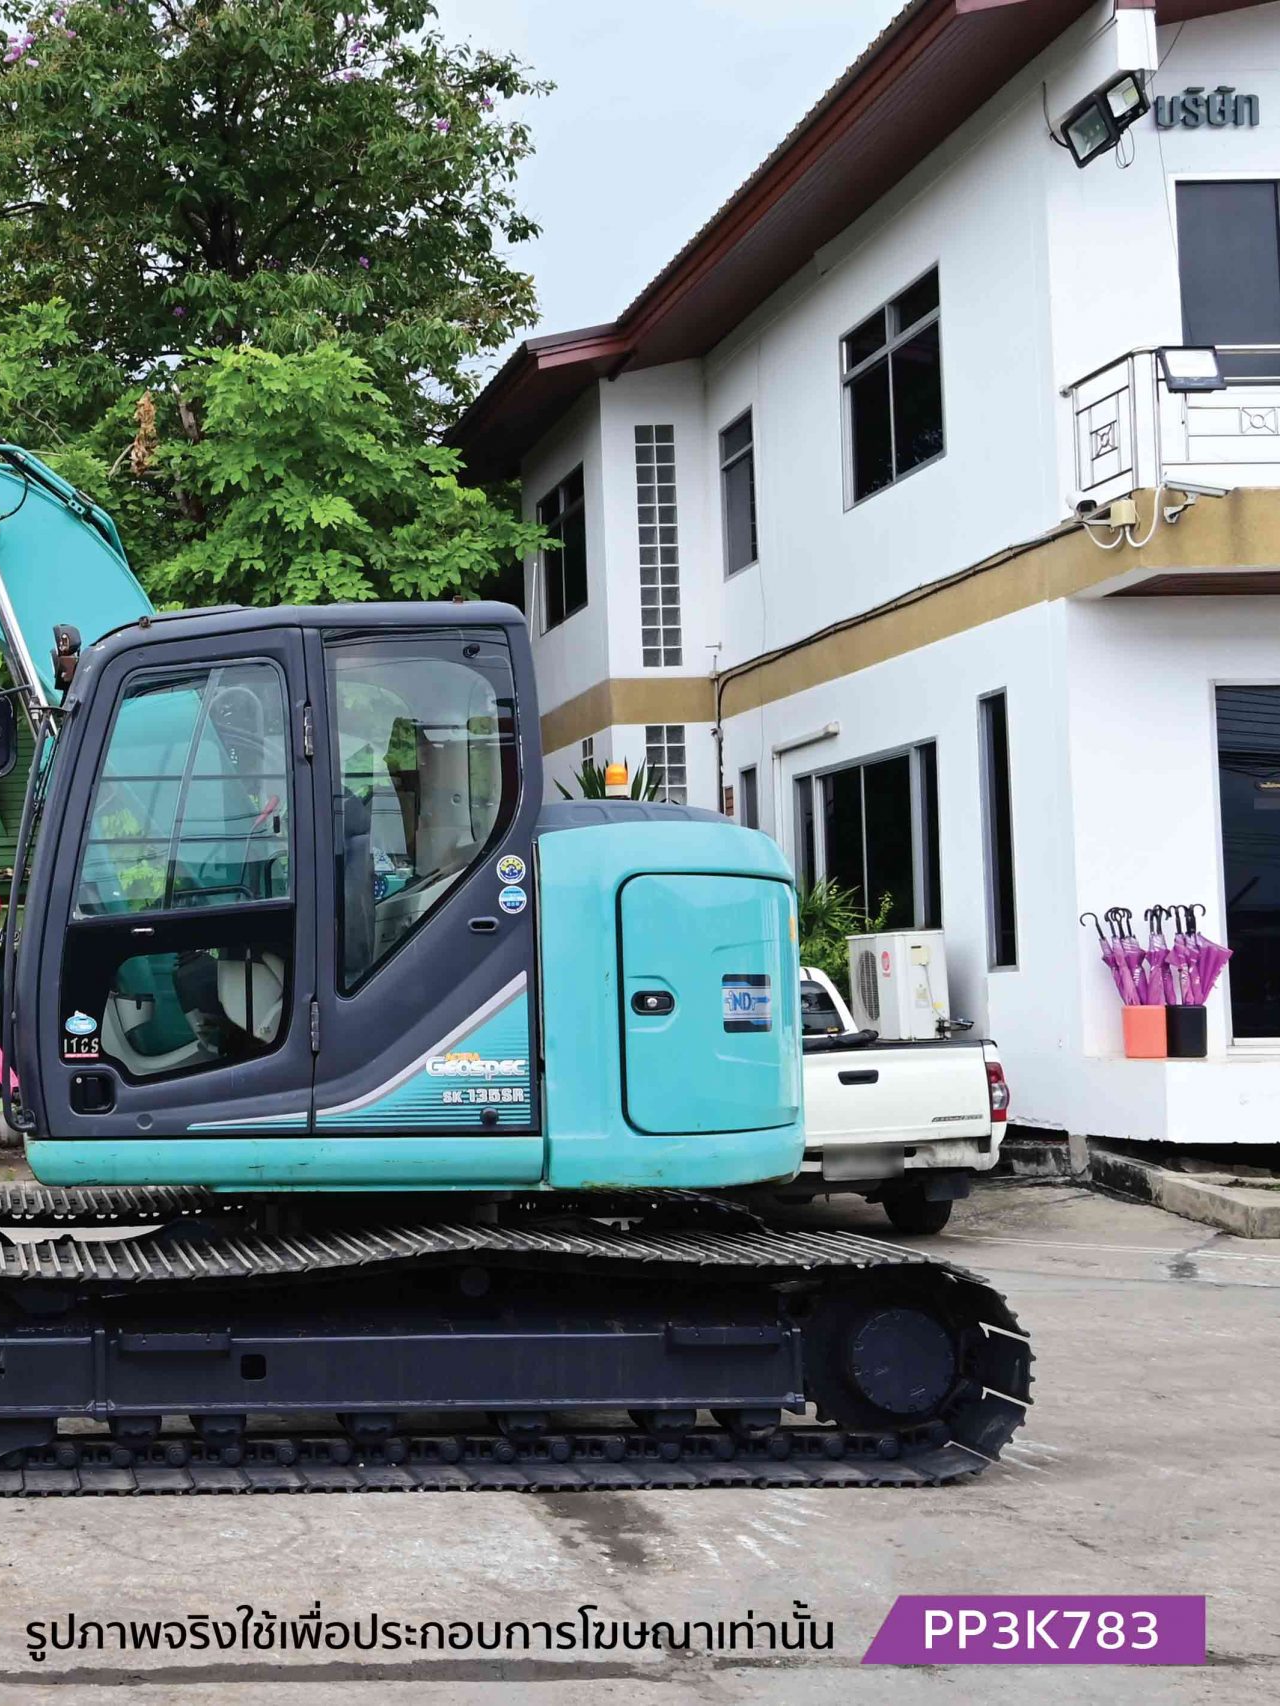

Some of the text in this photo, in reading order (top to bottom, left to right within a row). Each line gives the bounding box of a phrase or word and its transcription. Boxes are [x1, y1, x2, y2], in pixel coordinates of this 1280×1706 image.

[1154, 85, 1260, 127] บริษัท
[63, 1037, 99, 1053] ITCS
[426, 1056, 526, 1080] Geospec
[442, 1087, 524, 1103] SK 135SR
